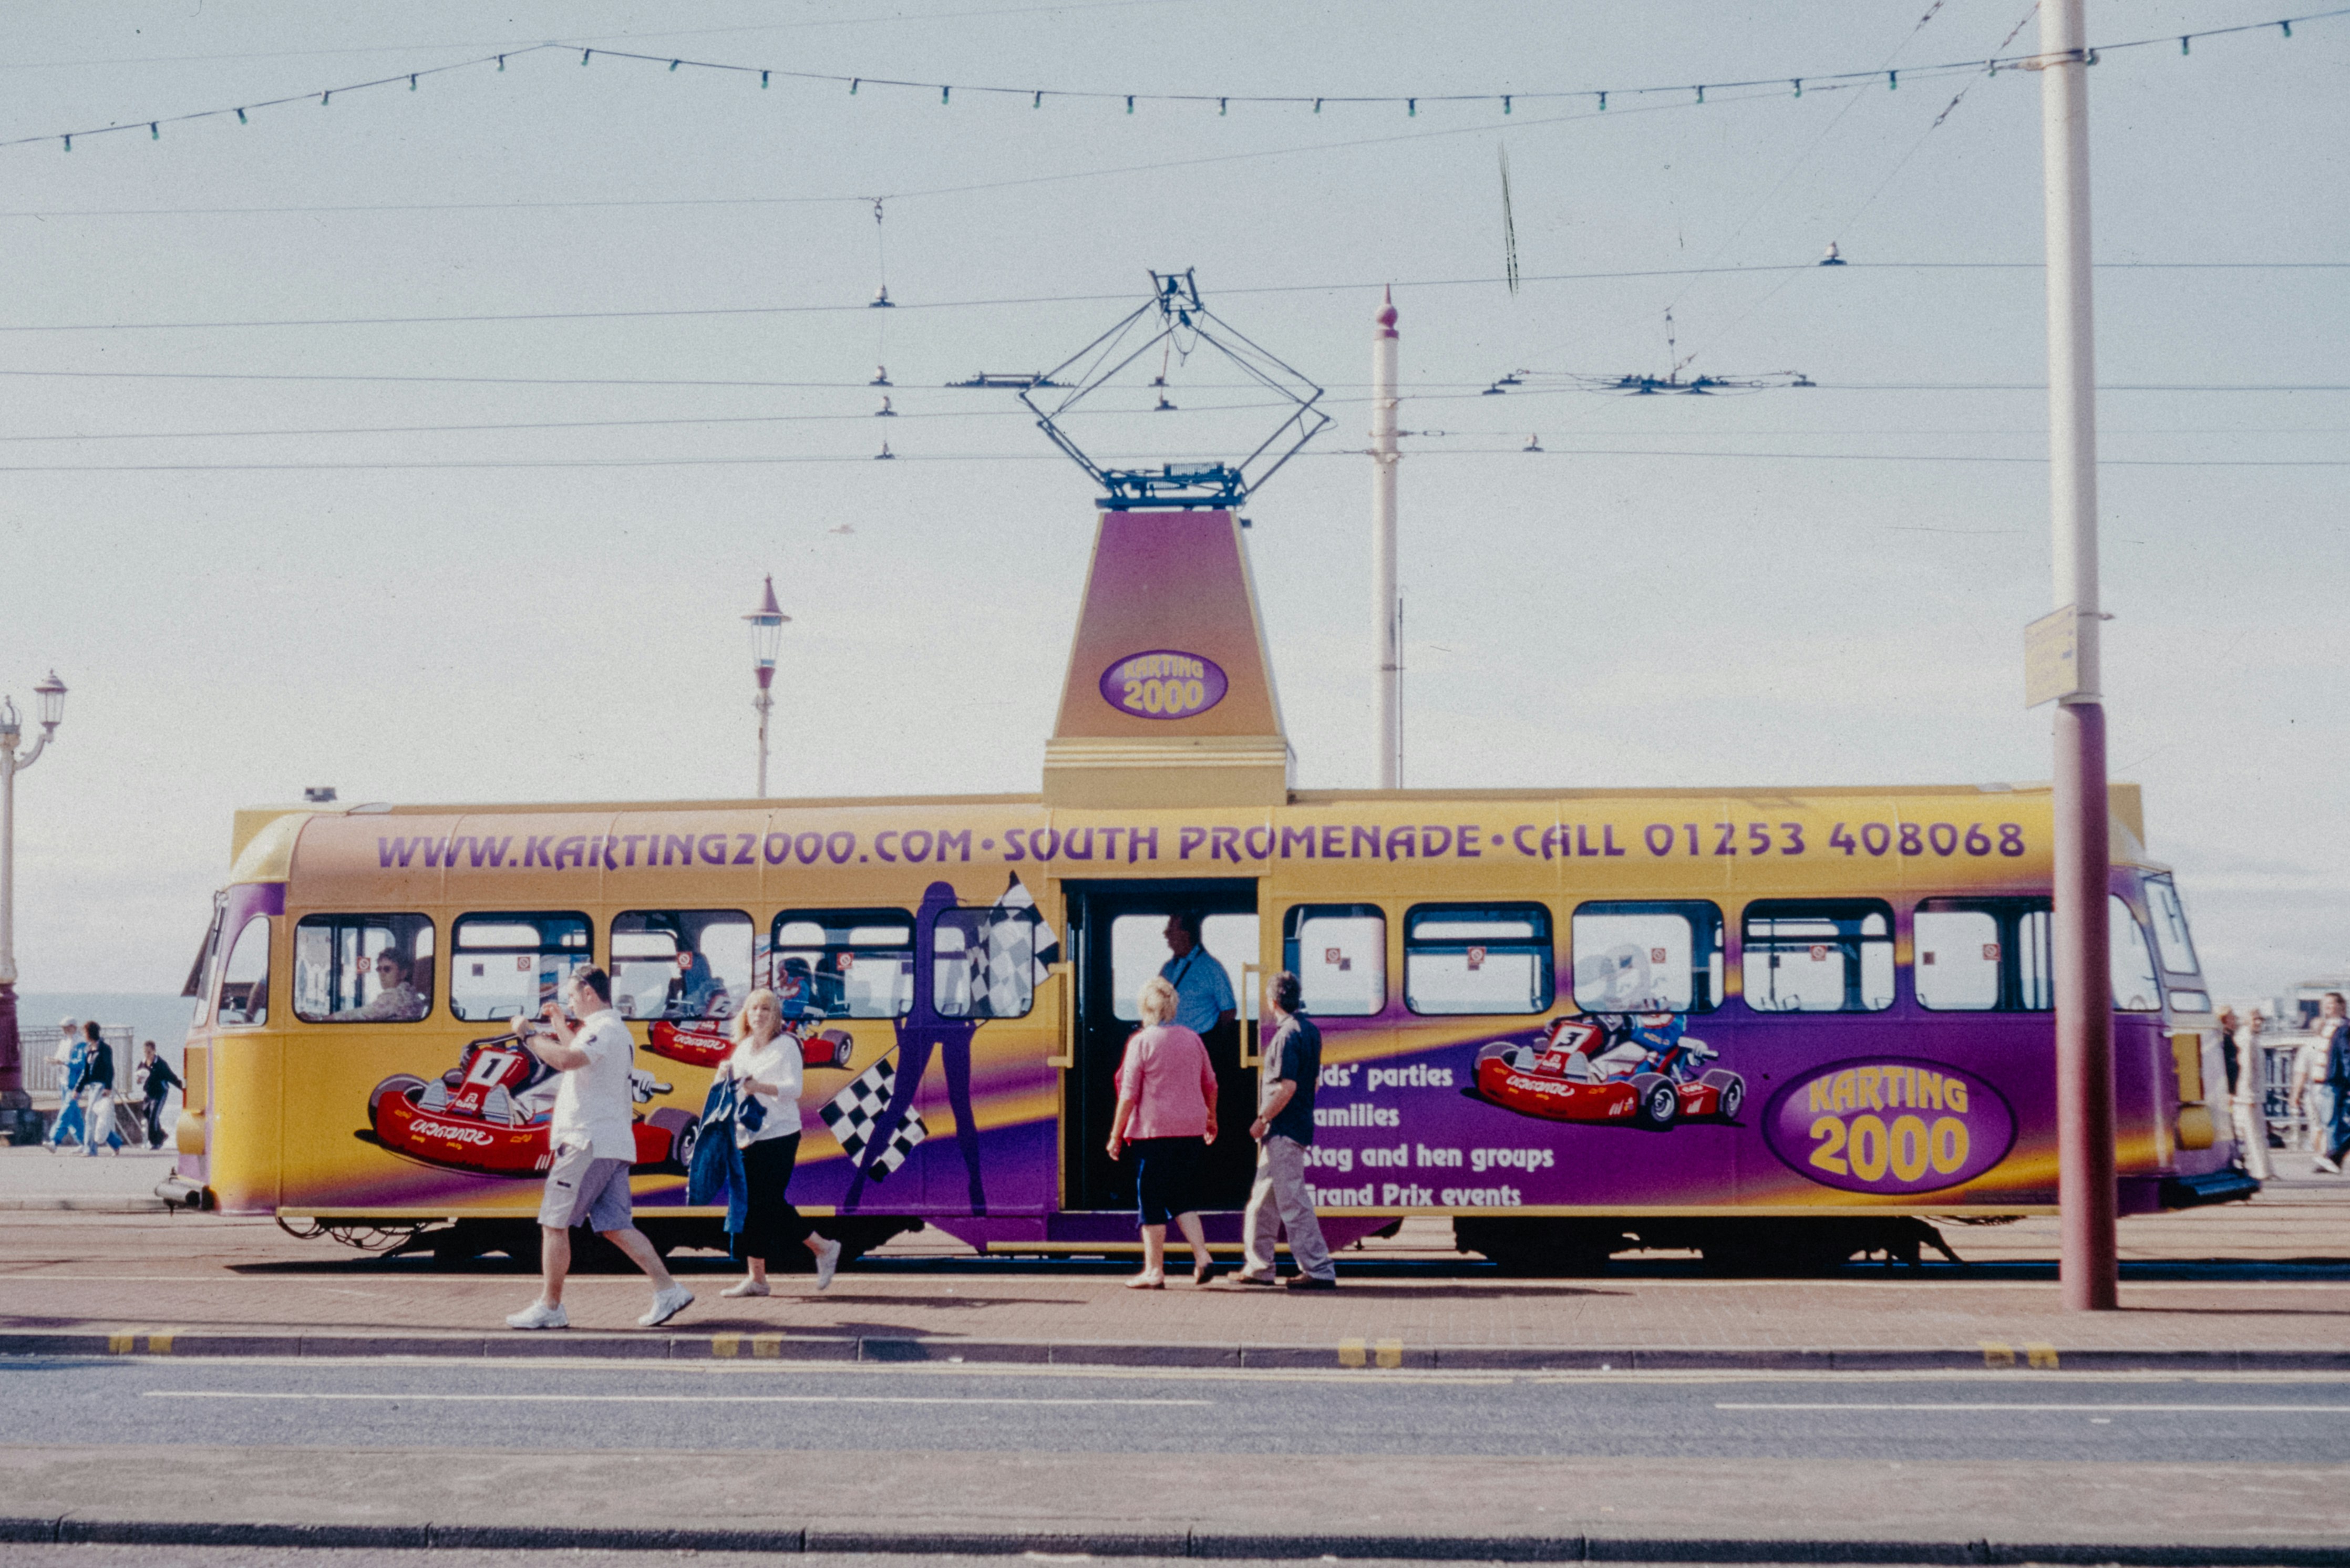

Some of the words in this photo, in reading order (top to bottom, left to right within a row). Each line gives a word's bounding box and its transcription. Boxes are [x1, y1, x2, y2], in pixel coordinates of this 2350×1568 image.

[1124, 655, 1204, 678] KARTING
[1124, 679, 1204, 714] 2000
[1003, 827, 1158, 864] SOUTH
[1179, 824, 1482, 863] PROMENADE
[1512, 823, 1626, 860] CALL
[1644, 822, 1806, 857] 01253
[1829, 822, 2025, 857] 408068
[481, 1058, 502, 1079] 1
[1319, 1064, 1359, 1087] ids'
[1368, 1064, 1453, 1092] parties
[1809, 1065, 1968, 1113] KARTING
[1313, 1103, 1400, 1127] amilies
[1361, 1144, 1408, 1167] and
[1417, 1144, 1463, 1167] hen
[1471, 1147, 1555, 1172] groups
[1809, 1114, 1970, 1182] 2000
[1382, 1183, 1434, 1206] Prix
[1441, 1184, 1521, 1206] events
